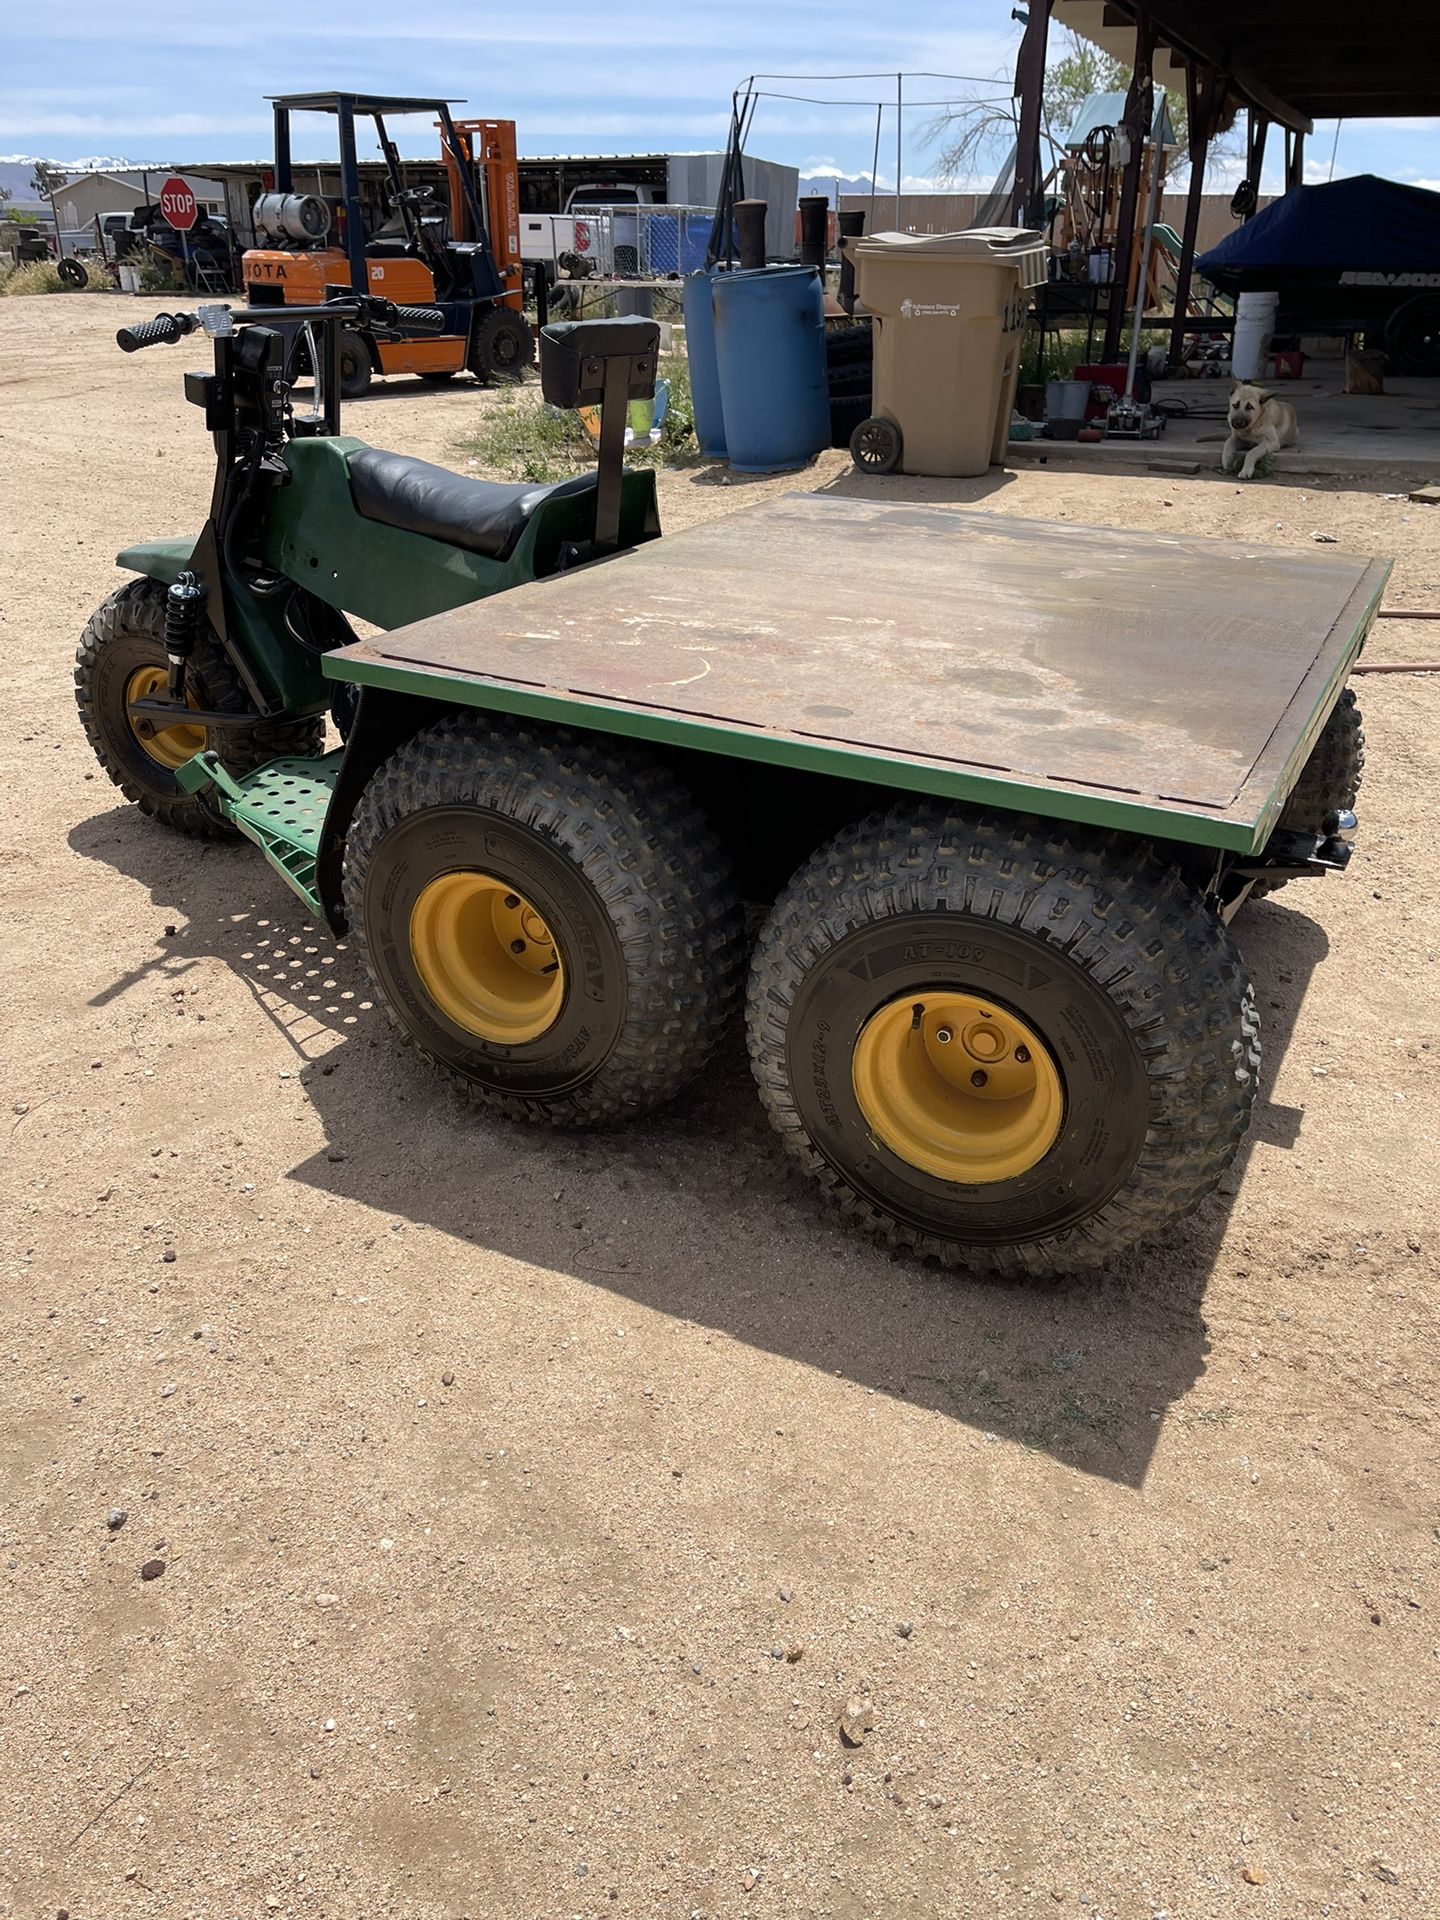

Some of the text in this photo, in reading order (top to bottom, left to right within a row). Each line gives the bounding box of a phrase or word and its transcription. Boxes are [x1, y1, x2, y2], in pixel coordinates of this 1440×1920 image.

[162, 194, 193, 213] STOP
[371, 266, 385, 280] 20
[903, 943, 987, 962] AT-109
